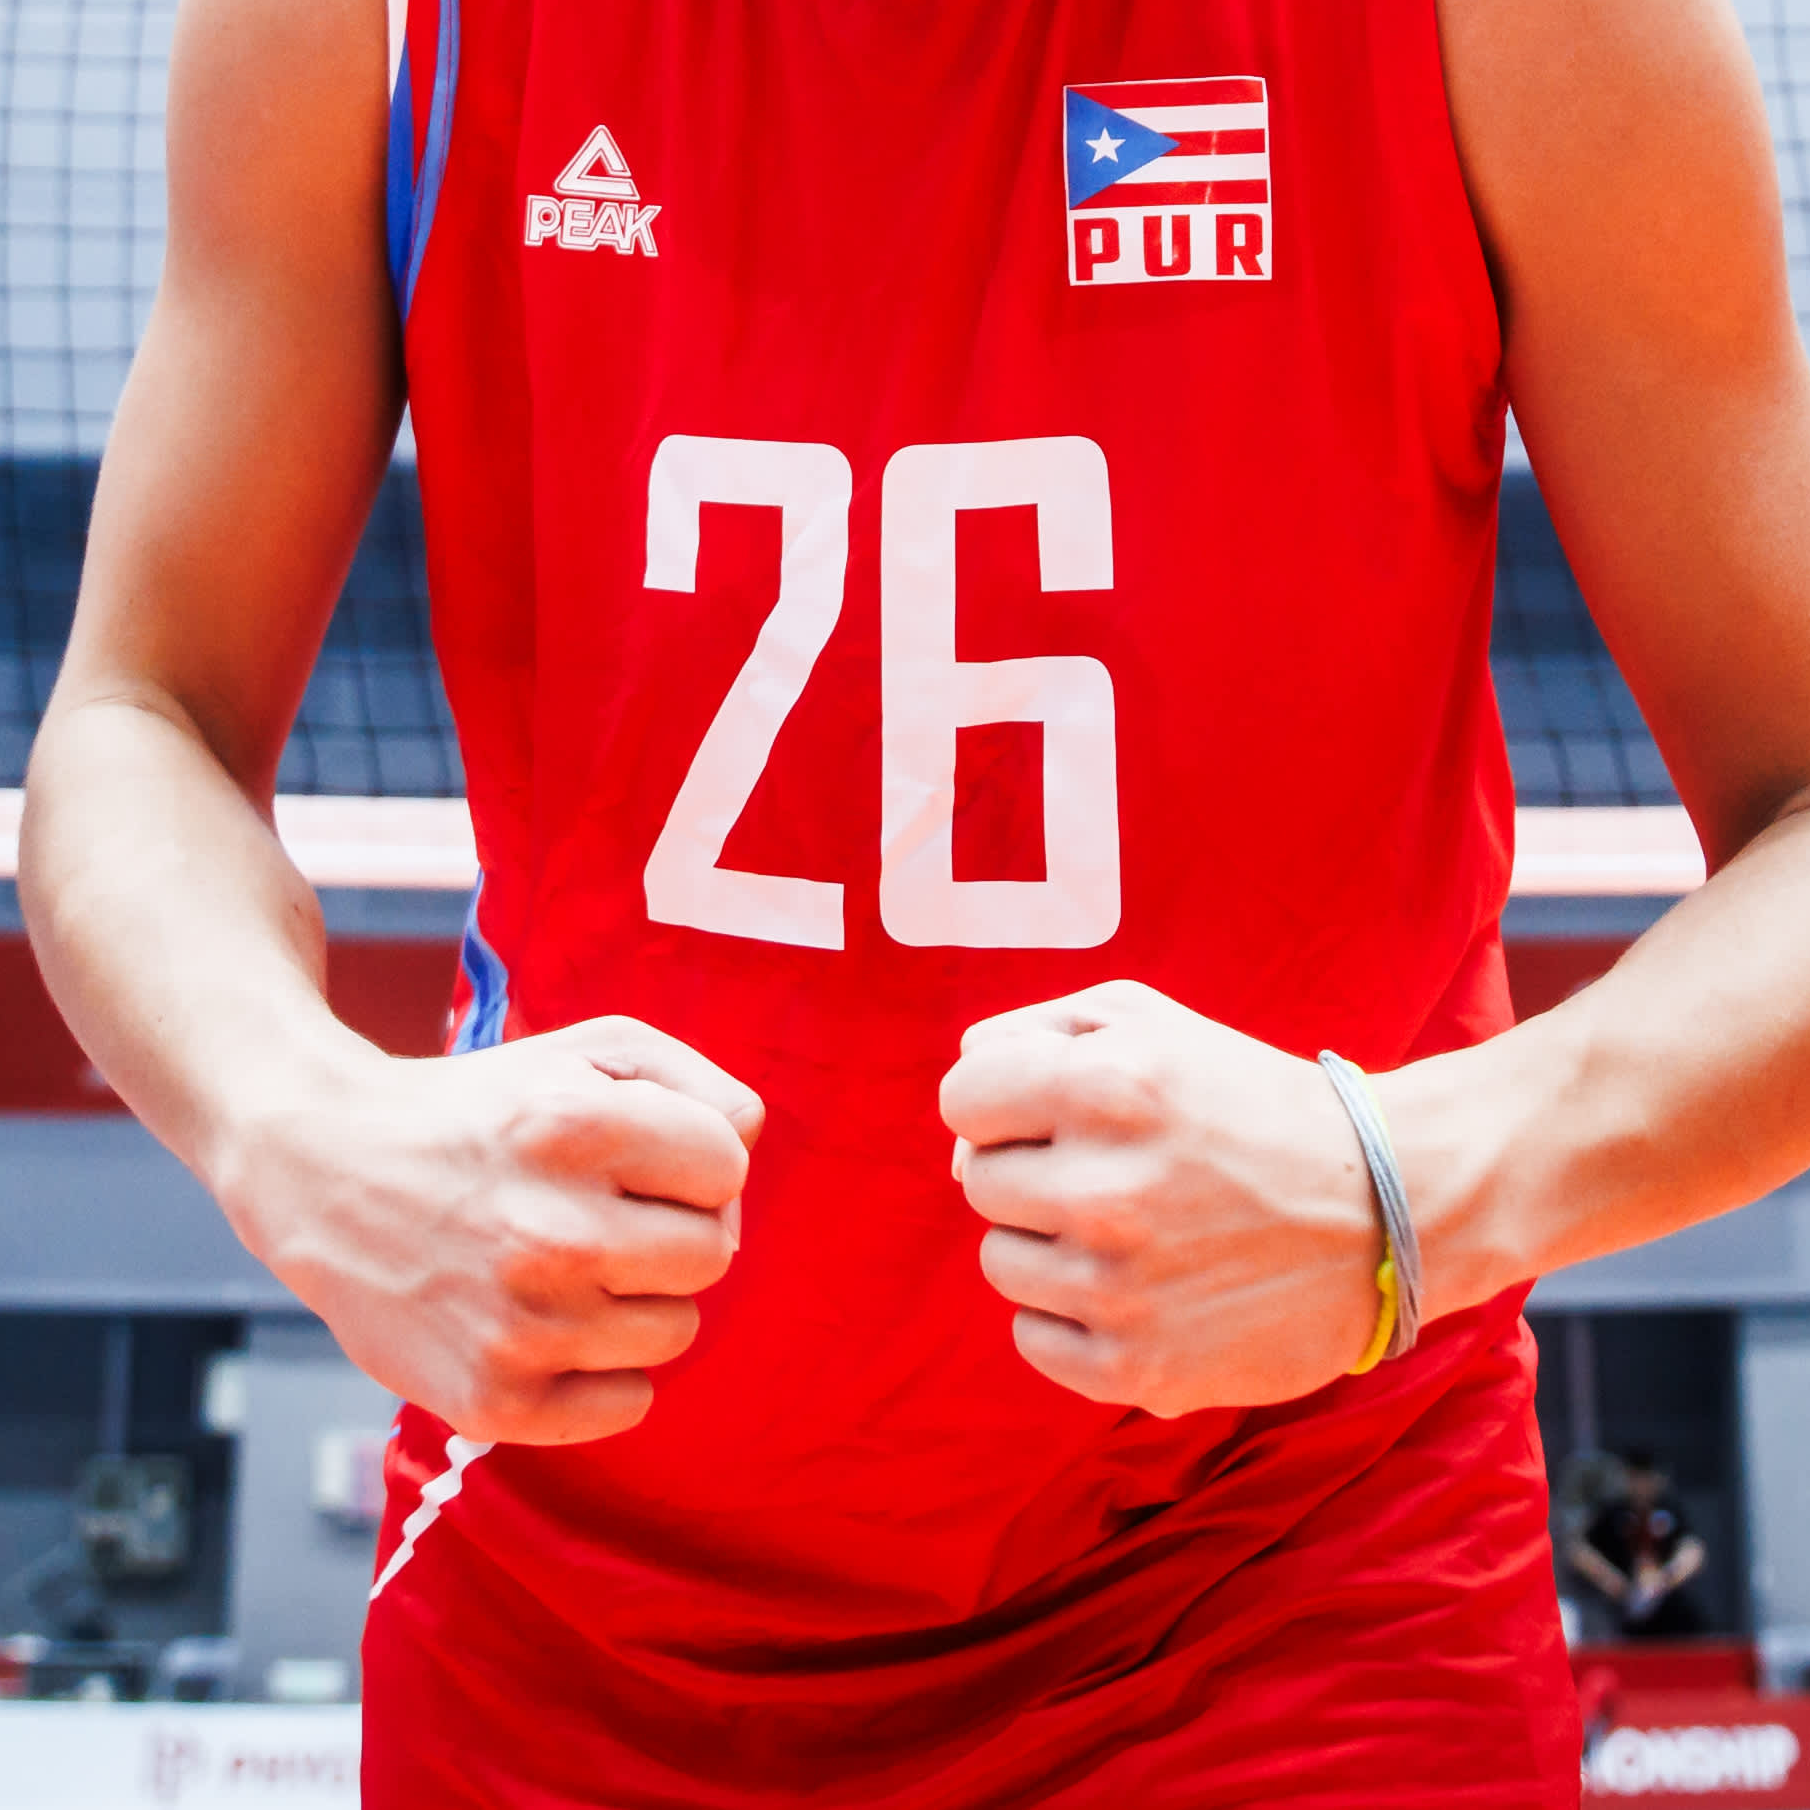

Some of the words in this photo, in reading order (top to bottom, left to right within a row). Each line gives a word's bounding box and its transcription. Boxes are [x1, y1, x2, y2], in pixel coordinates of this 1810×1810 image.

[525, 195, 662, 257] PEAK
[1074, 213, 1264, 281] PUR
[643, 434, 1121, 950] 26
